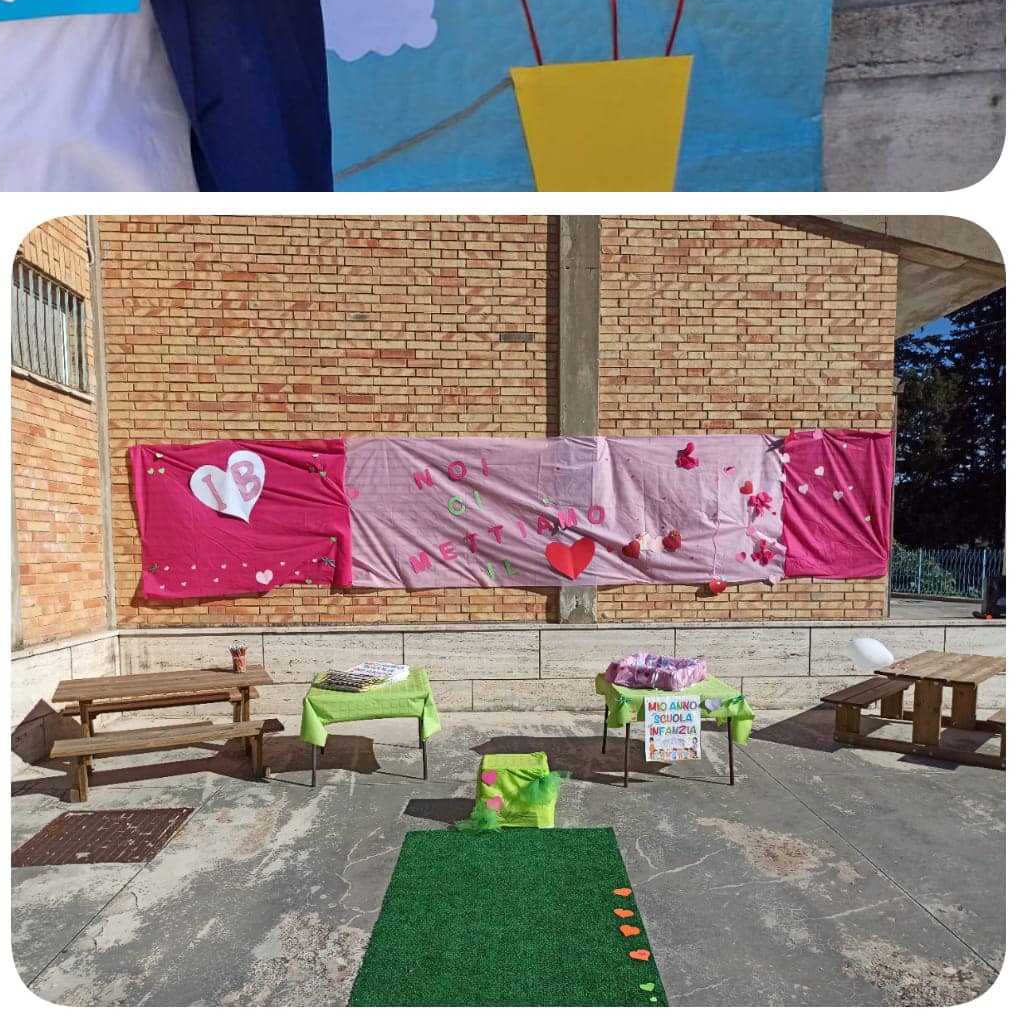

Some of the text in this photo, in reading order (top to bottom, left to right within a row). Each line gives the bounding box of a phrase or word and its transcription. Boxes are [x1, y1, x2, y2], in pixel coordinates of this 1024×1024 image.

[413, 457, 489, 490] NOI
[447, 490, 483, 516] CI
[409, 505, 606, 574] METTIAMO
[486, 559, 519, 581] IL
[648, 701, 697, 711] MIO ANNO
[653, 713, 693, 724] SCUOLA
